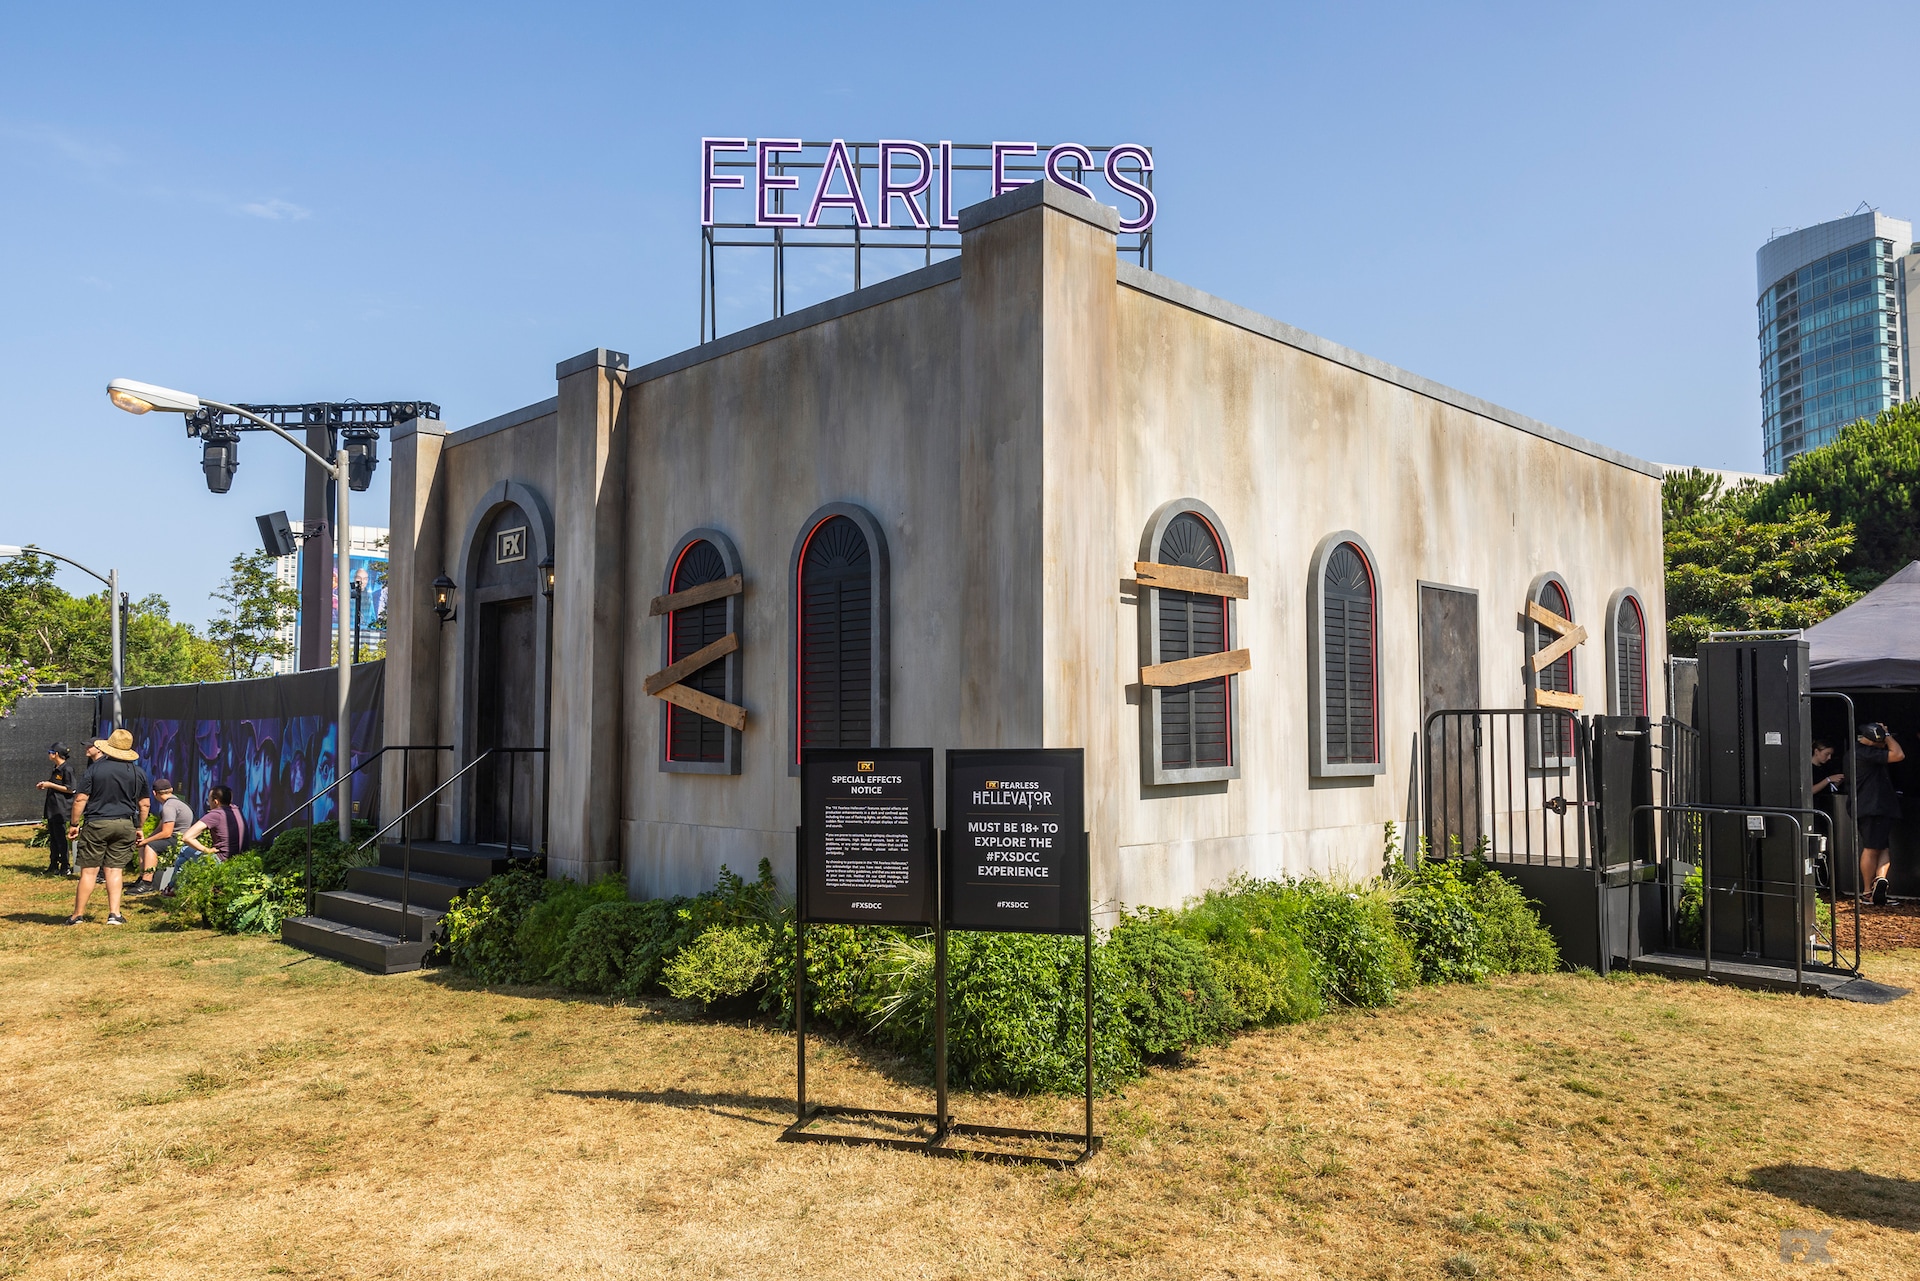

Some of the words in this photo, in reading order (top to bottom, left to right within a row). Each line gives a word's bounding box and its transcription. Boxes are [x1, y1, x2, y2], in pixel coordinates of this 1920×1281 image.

[701, 137, 1157, 233] FEARLESS
[831, 775, 865, 784] SPECIAL
[867, 775, 902, 784] EFFECTS
[851, 786, 882, 795] NOTICE
[1000, 781, 1040, 790] FEARLESS
[972, 791, 1053, 811] HELLEVATOR
[968, 822, 1001, 833] MUST
[1003, 822, 1018, 833] BE
[1020, 822, 1039, 834] 18+
[1042, 823, 1059, 834] TO
[974, 836, 1026, 848] EXPLORE
[1029, 837, 1053, 848] THE
[986, 852, 1040, 862] #FXSDCC
[977, 866, 1049, 878] EXPERIENCE
[851, 902, 882, 910] #FXSDCC
